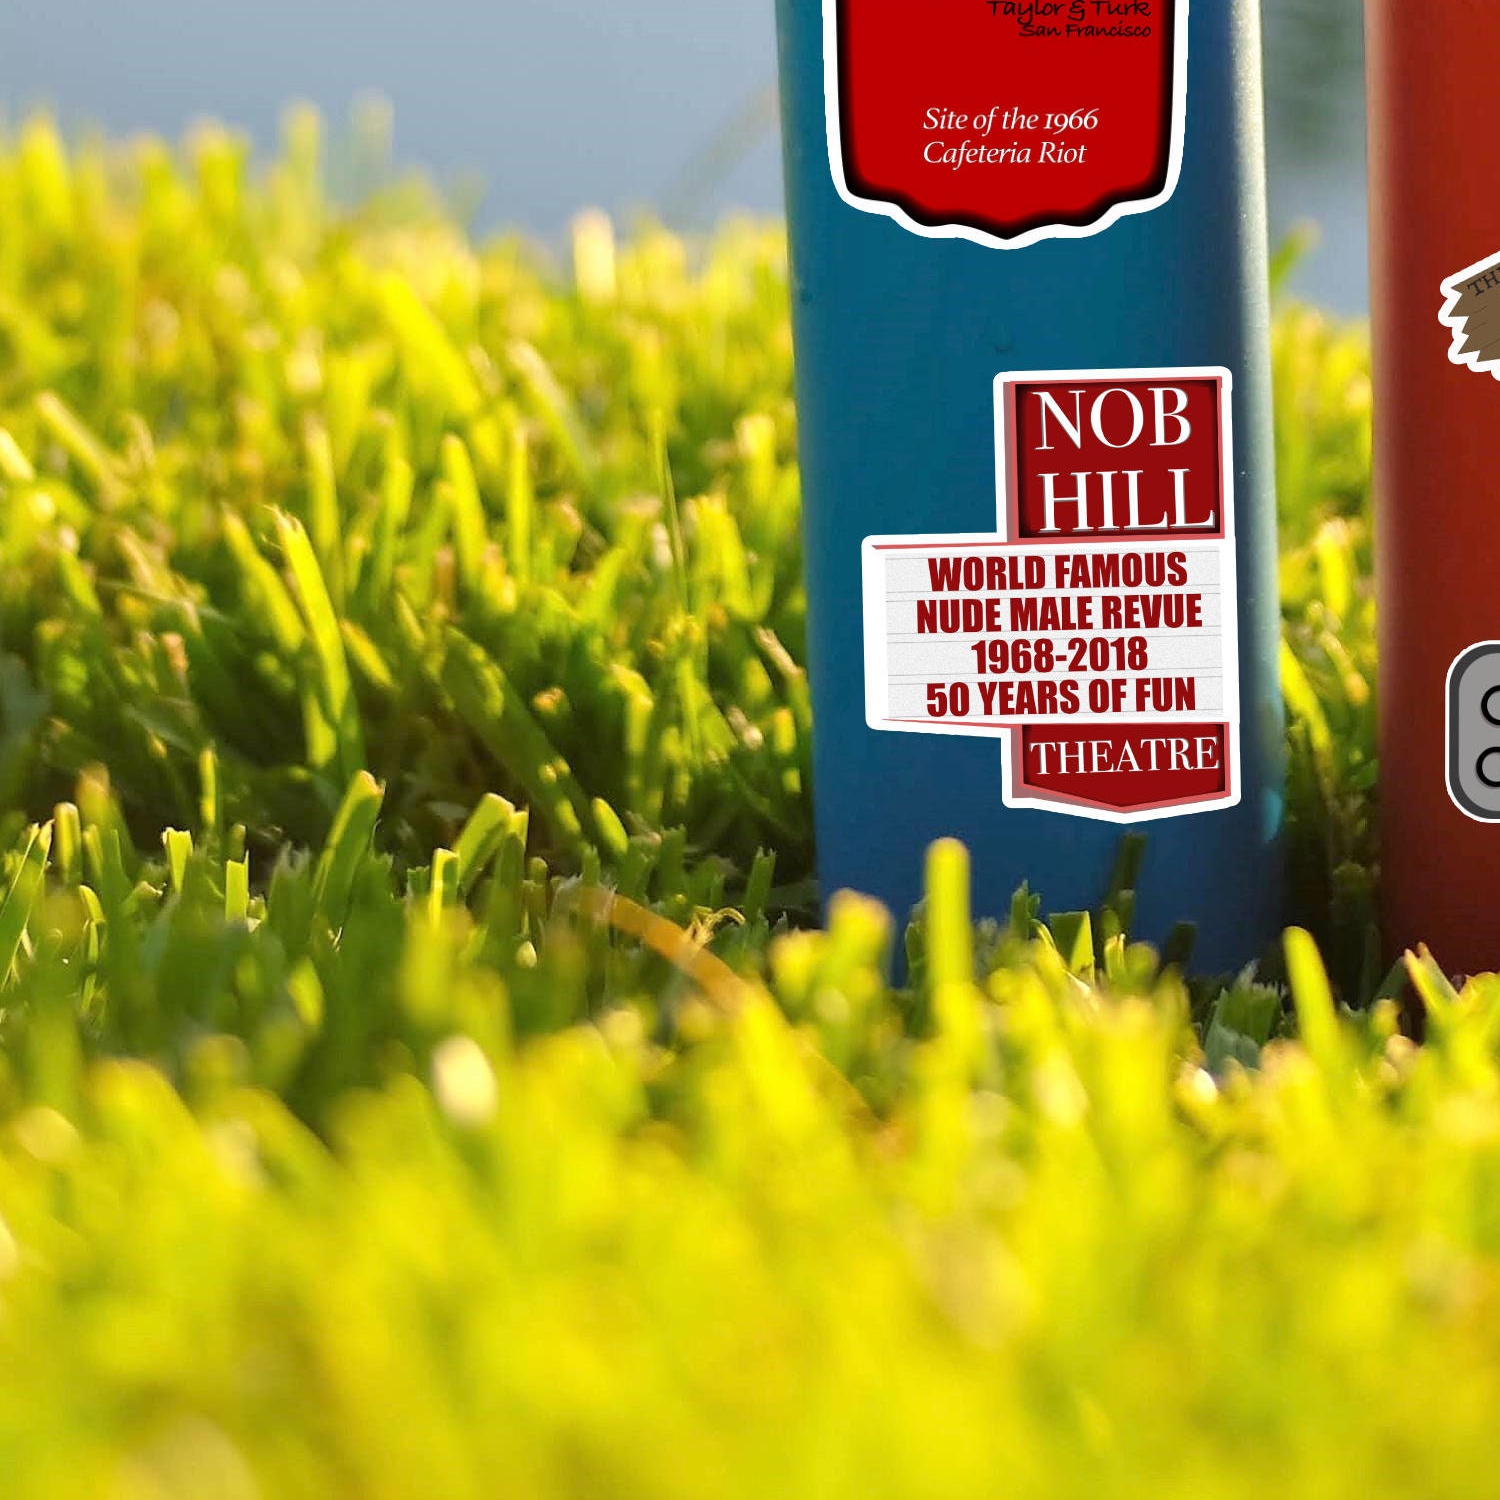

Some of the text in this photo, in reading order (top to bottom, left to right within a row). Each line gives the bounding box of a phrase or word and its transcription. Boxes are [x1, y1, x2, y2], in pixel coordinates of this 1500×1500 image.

[1018, 21, 1152, 38] San Francisco
[1069, 0, 1085, 20] &
[923, 106, 1099, 137] Site of the 1966
[922, 140, 1088, 171] Cafeteria Riot
[1031, 387, 1193, 451] NOB
[1036, 468, 1216, 534] HILL
[927, 551, 1188, 592] WORLD FAMOUS
[916, 593, 1203, 634] NUDE MALE REVUE
[970, 636, 1148, 674] 1968-2018
[926, 676, 1196, 718] 50 YEARS OF FUN
[1028, 735, 1220, 776] THEATRE
